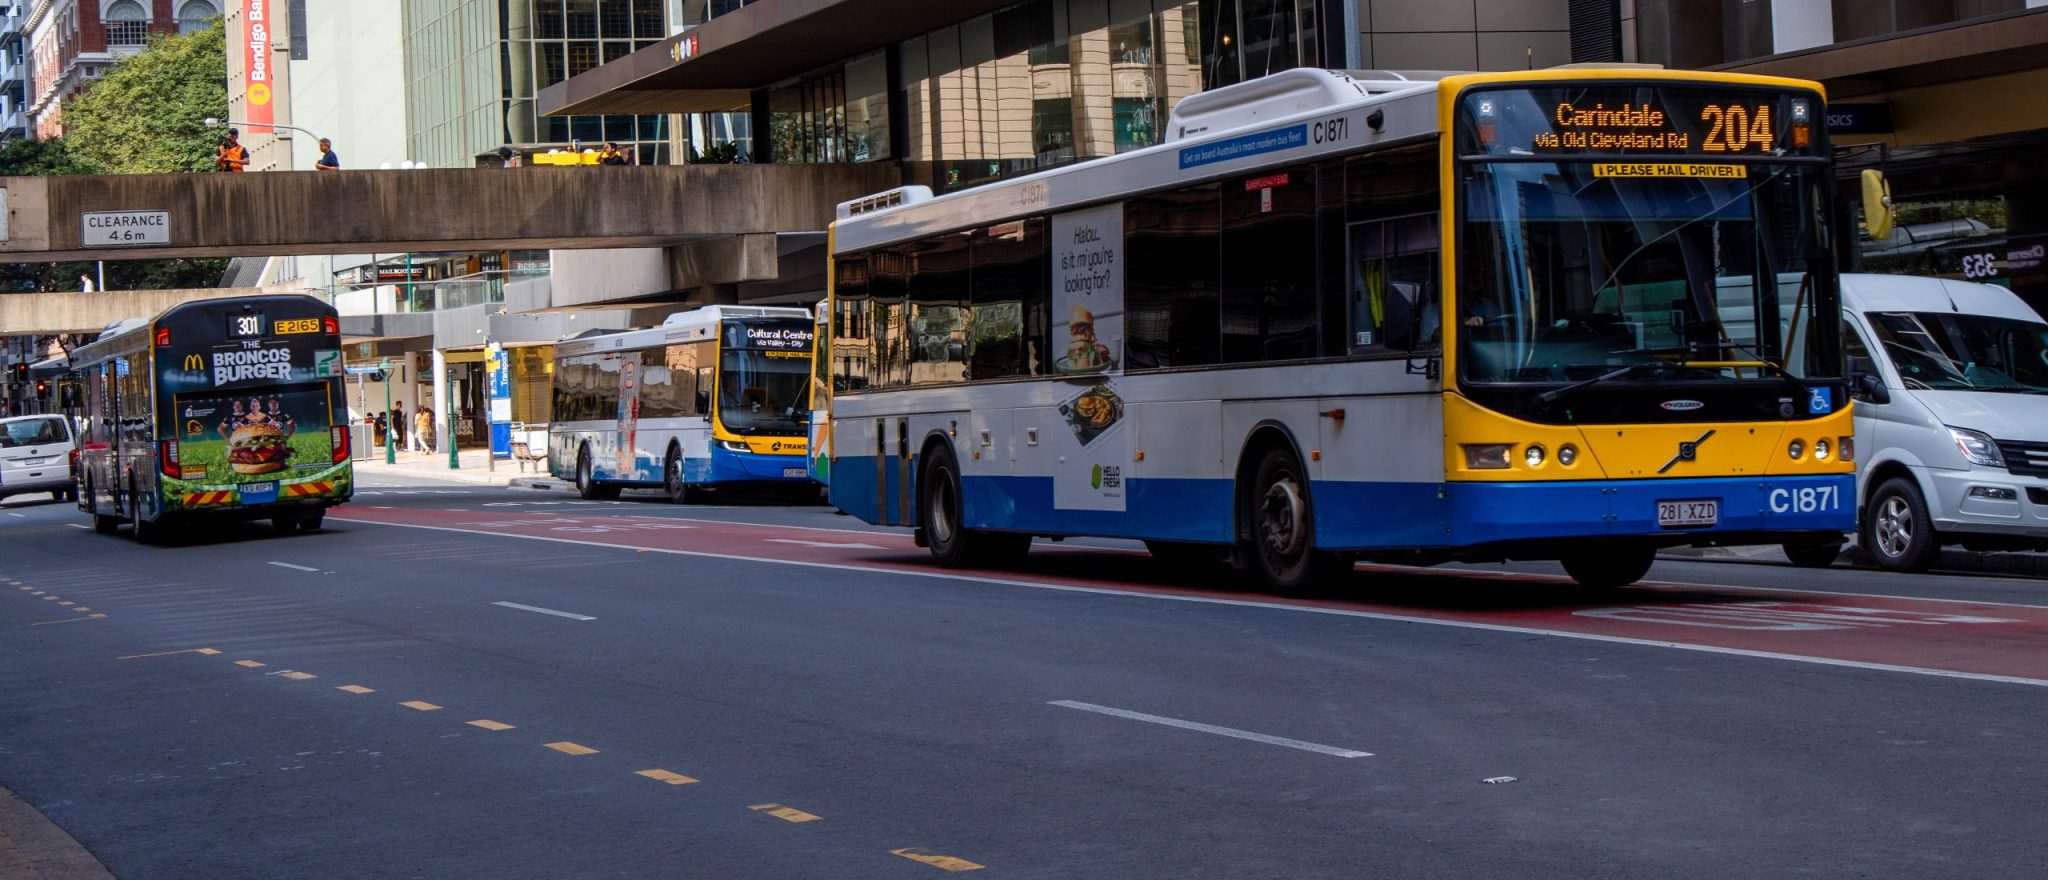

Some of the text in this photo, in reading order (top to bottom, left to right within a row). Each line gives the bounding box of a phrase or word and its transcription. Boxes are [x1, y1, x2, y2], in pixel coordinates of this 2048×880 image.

[249, 0, 266, 80] Bendigo Ba
[1557, 103, 1663, 127] Carindale
[1314, 117, 1348, 144] C1871
[1702, 105, 1772, 151] 204
[1184, 131, 1301, 163] Get on board Australia's most modern bus fleet
[1535, 132, 1688, 149] via Old Cleveland Rd
[1607, 165, 1734, 177] PLEASE HAIL DRIVER
[1020, 185, 1043, 205] C1871
[89, 215, 163, 228] CLEARANCE
[1061, 246, 1113, 271] is it mi you're
[1064, 270, 1110, 295] looking for?
[238, 317, 258, 335] 301
[276, 320, 318, 333] E 2165
[747, 328, 813, 340] Cultural Centre
[242, 340, 261, 349] THE
[213, 348, 291, 366] BRONCOS
[214, 362, 292, 387] BURGER
[1103, 466, 1120, 477] HELLO
[1103, 477, 1120, 488] FRESH
[1769, 485, 1838, 513] C1871
